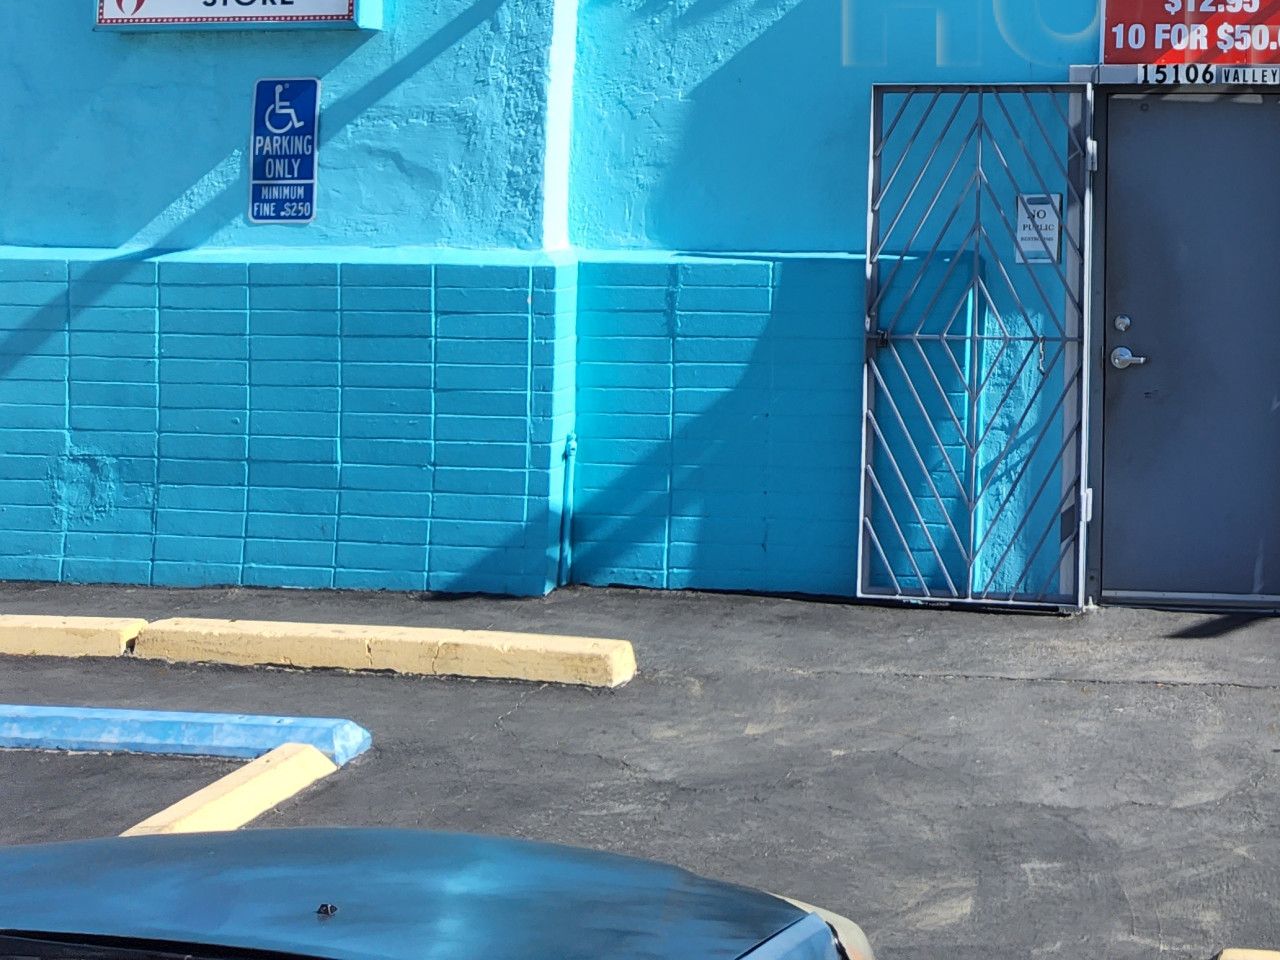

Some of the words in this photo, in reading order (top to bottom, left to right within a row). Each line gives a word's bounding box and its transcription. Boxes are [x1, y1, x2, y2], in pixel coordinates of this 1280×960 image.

[1112, 23, 1146, 49] 10
[1154, 23, 1208, 50] FOR
[1141, 64, 1214, 84] 15106
[1223, 68, 1279, 83] VALLEY
[255, 135, 312, 155] PARKING
[265, 158, 301, 178] ONLY
[261, 186, 304, 200] MINIMUM
[253, 202, 276, 216] FINE
